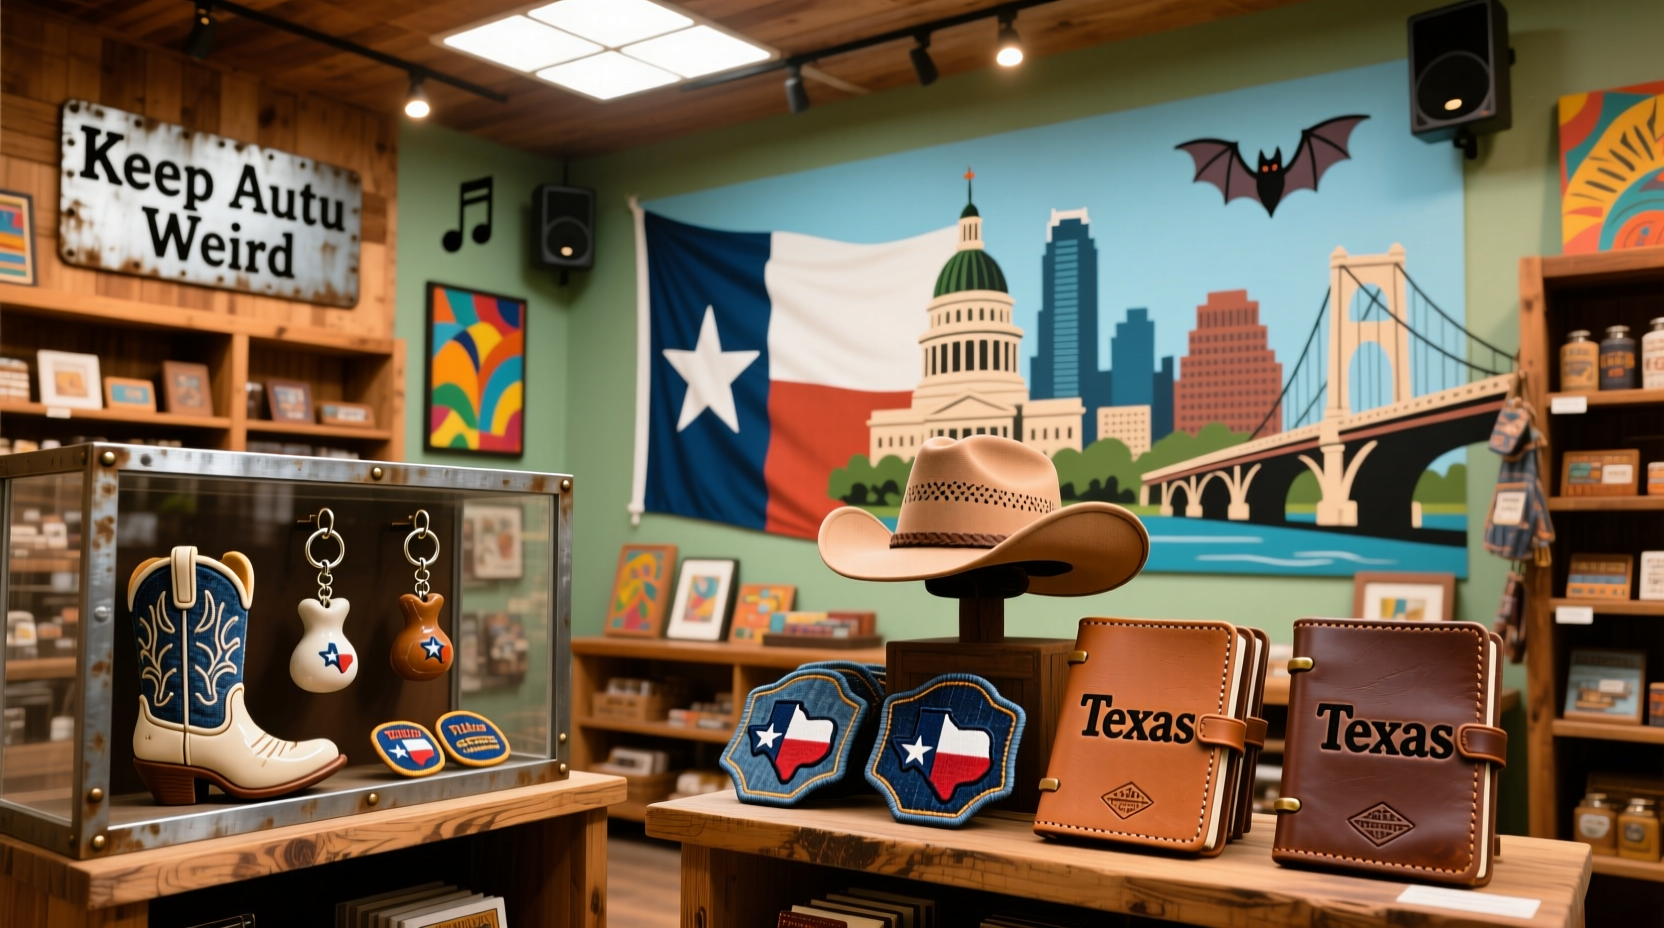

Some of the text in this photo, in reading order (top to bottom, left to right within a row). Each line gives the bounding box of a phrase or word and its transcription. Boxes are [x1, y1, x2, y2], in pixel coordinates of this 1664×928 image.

[80, 126, 345, 232] Keep Autu
[142, 206, 295, 279] Weird
[1080, 693, 1196, 745] Texas
[1316, 701, 1454, 760] Texas
